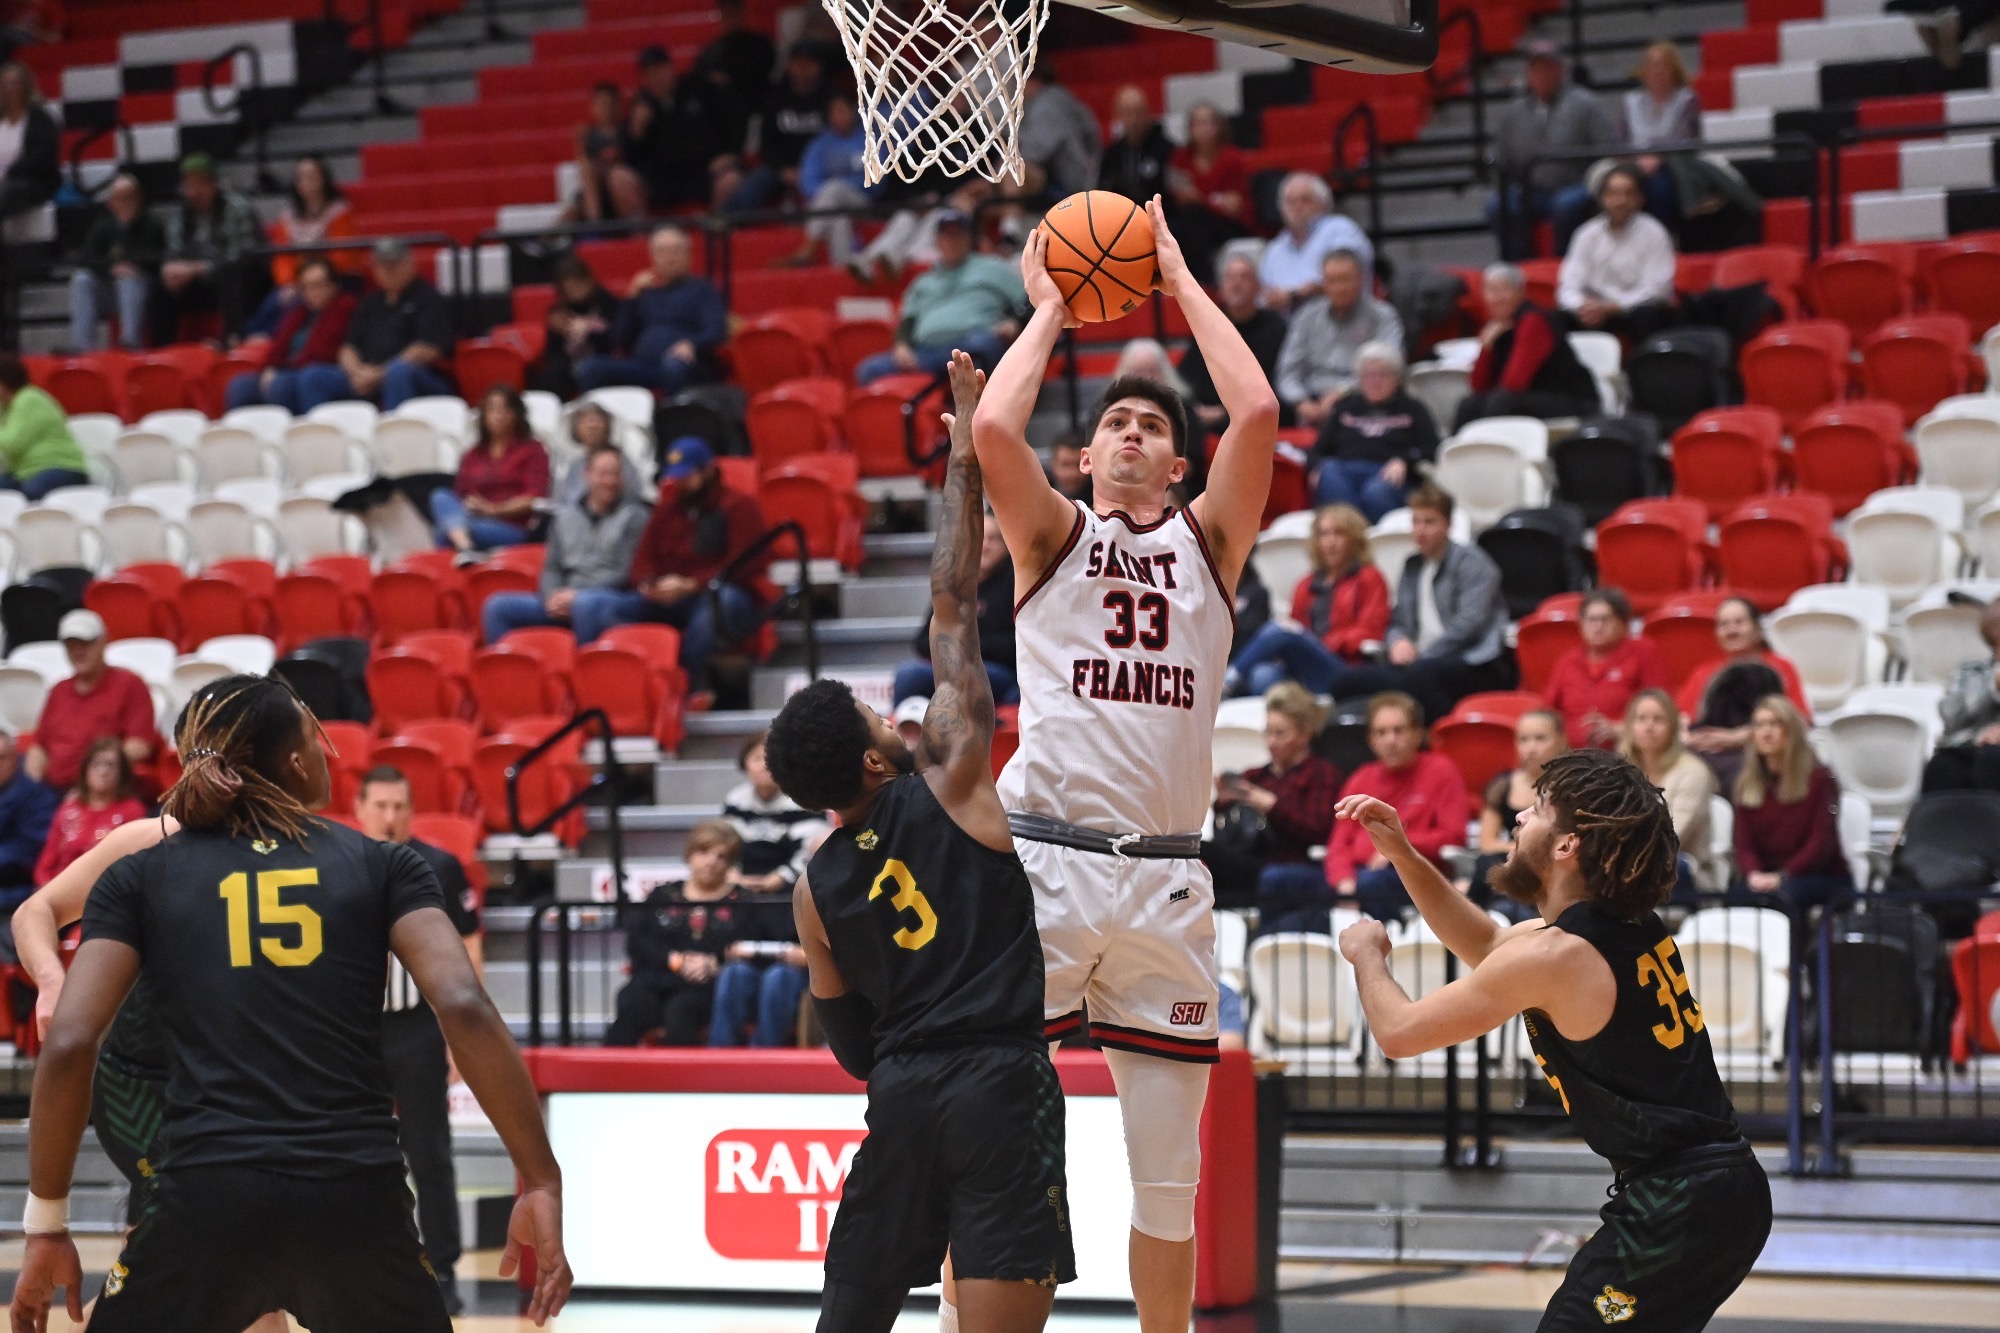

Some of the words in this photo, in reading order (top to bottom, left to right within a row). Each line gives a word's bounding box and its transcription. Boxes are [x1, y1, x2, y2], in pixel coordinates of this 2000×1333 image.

[1085, 541, 1178, 590] SAINT
[1103, 590, 1170, 652] 33
[1072, 659, 1195, 711] FRANCIS
[219, 868, 323, 967] 15
[868, 858, 938, 951] 3
[1169, 887, 1190, 901] NEC
[1170, 1002, 1208, 1026] SFU
[1636, 935, 1704, 1050] 35
[715, 1141, 862, 1194] RAM
